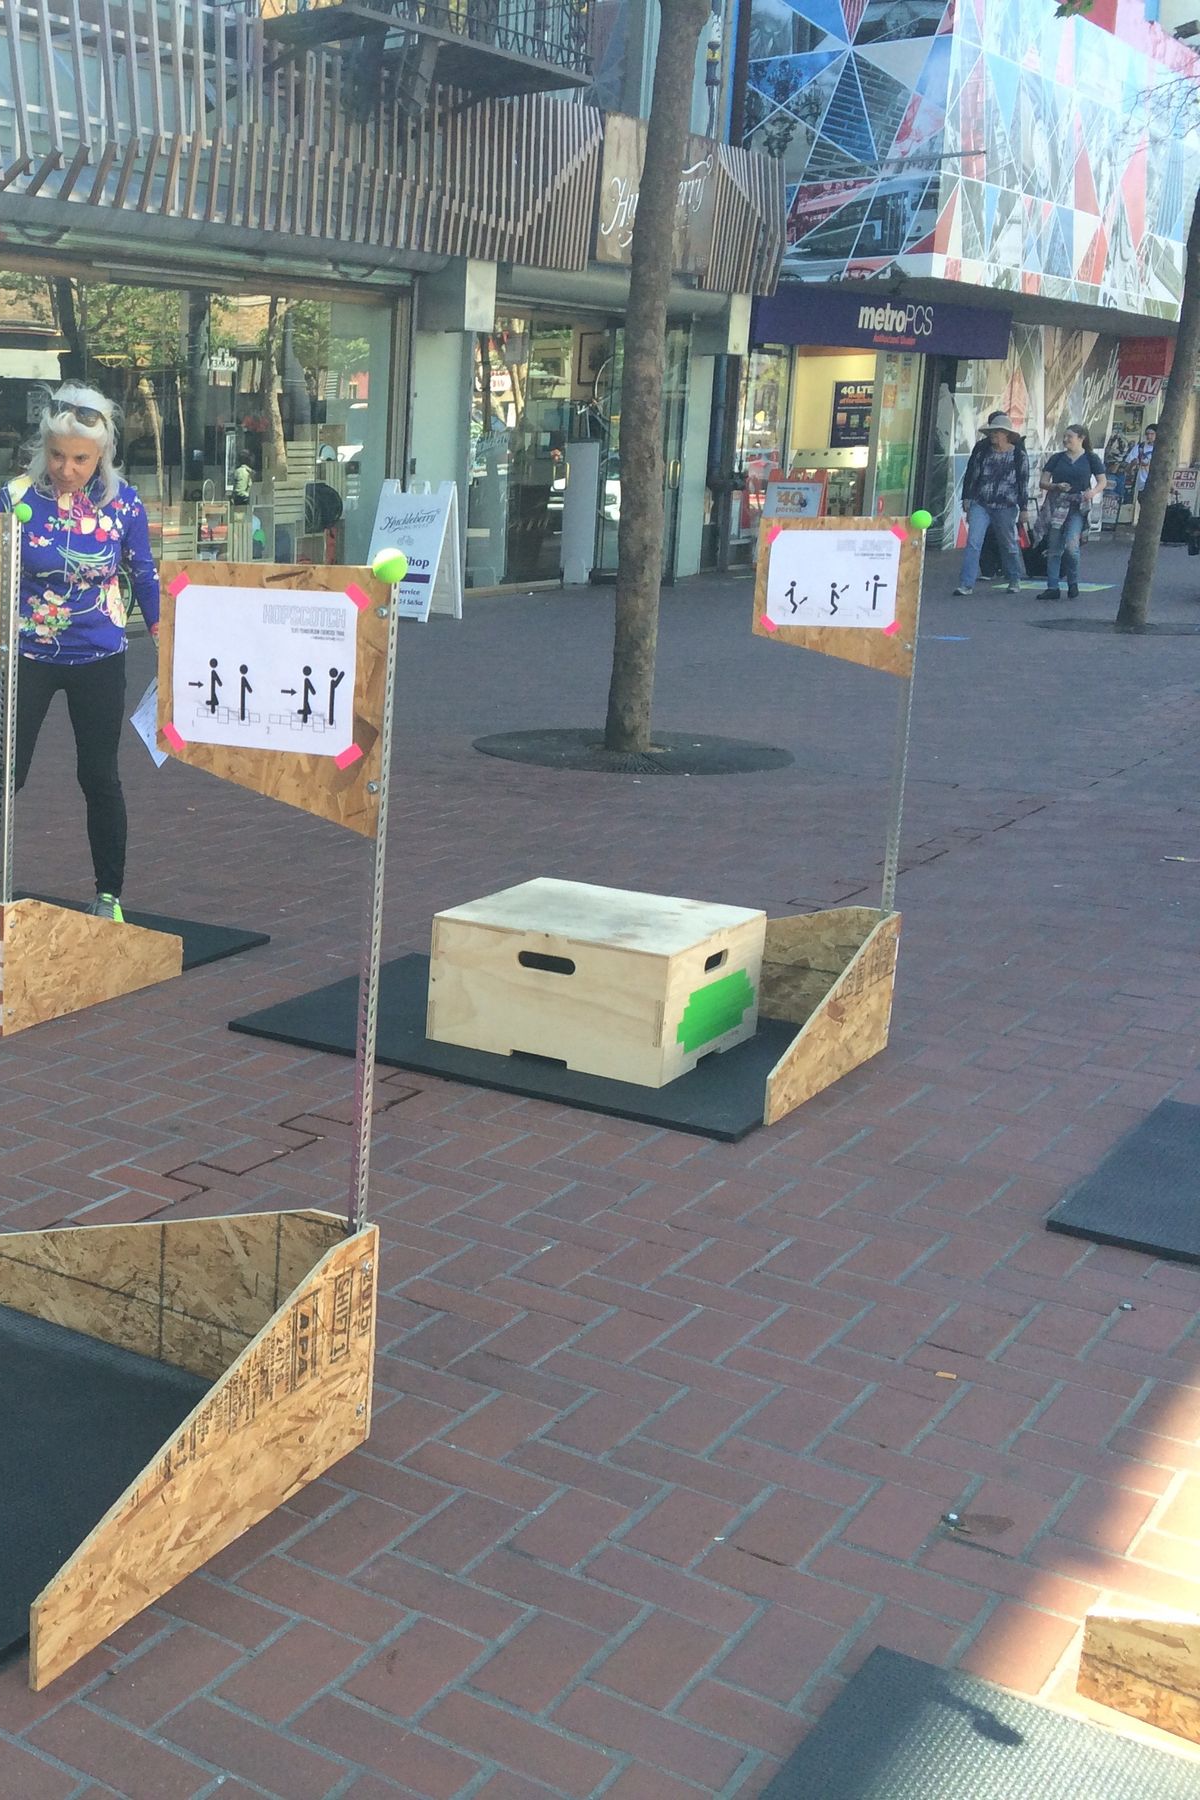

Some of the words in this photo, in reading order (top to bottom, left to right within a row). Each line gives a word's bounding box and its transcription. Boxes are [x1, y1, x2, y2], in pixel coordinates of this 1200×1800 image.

[858, 303, 934, 336] metroPCS
[841, 385, 855, 394] 4G
[856, 385, 874, 394] LTE
[1120, 375, 1162, 395] ATM
[1173, 471, 1195, 480] PEN
[262, 604, 347, 629] HOPSCOTCH
[335, 1278, 351, 1336] SHIFT
[297, 1311, 310, 1379] APA
